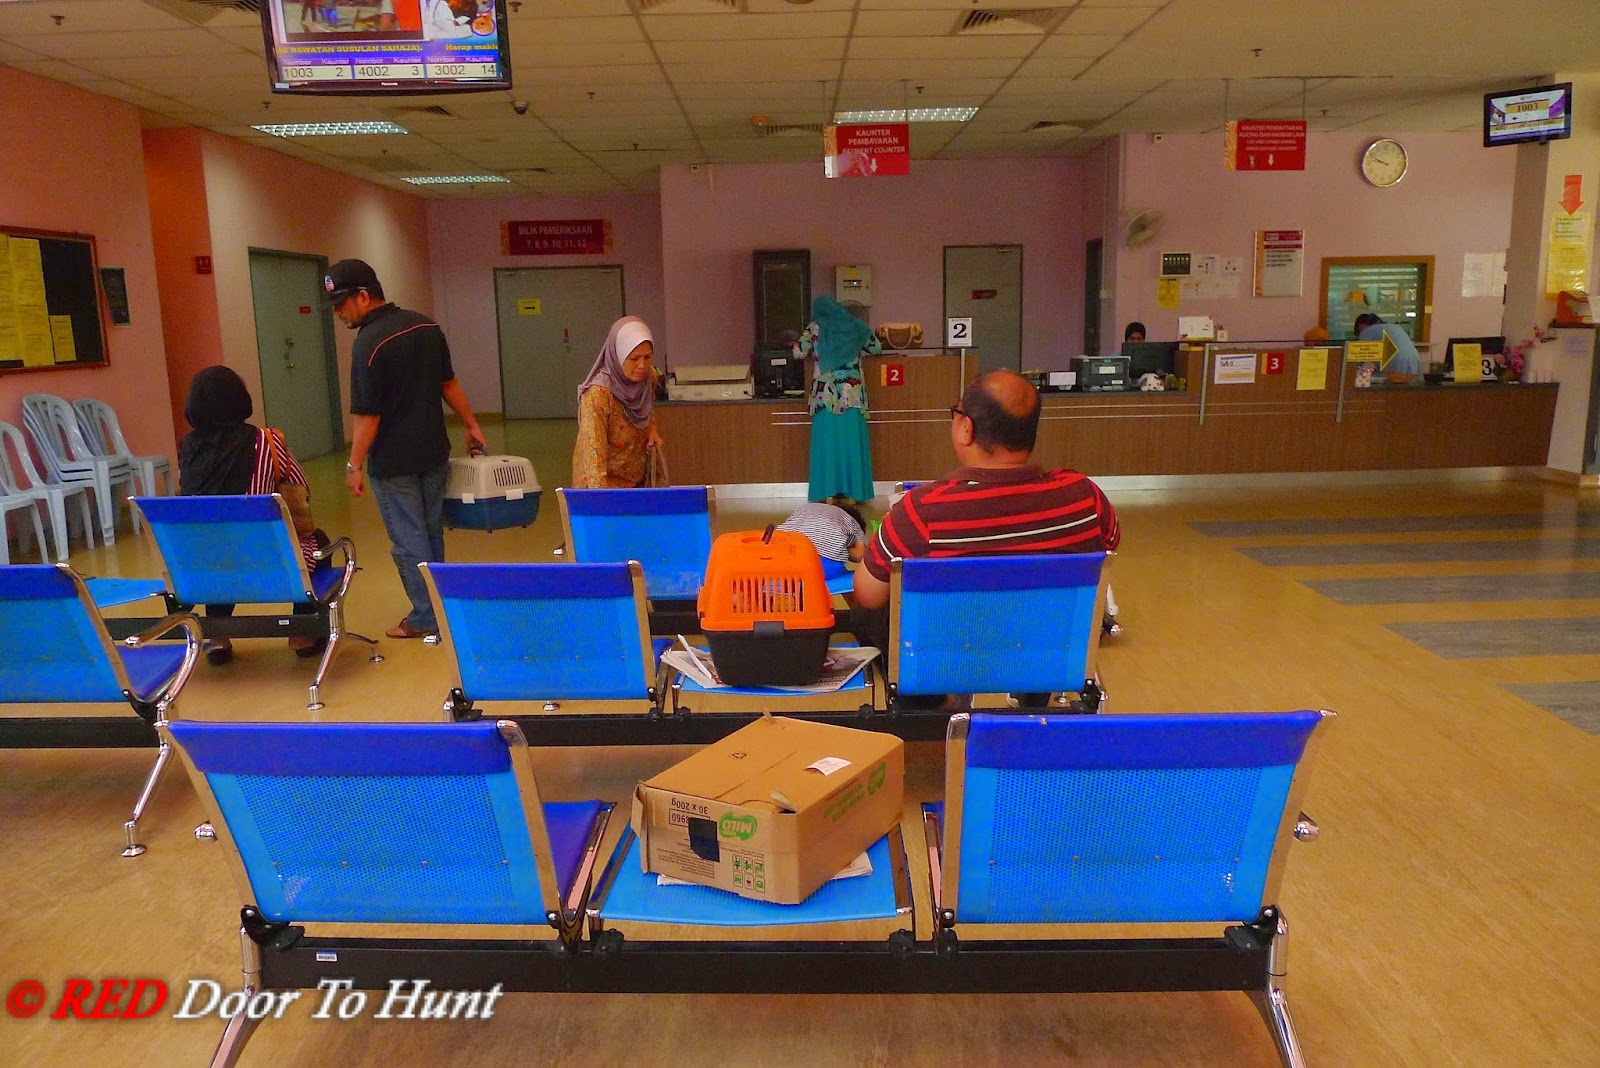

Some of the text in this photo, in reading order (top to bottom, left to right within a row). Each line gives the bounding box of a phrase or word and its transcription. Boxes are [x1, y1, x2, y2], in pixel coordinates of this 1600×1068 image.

[284, 65, 496, 78] 1003 2 4002 3 3002 14
[1517, 103, 1539, 112] 1003
[856, 129, 891, 137] KAUNTER
[848, 137, 898, 145] PEMBAYARAN
[873, 146, 905, 154] COUNTER
[540, 225, 593, 235] PEMERIKSAAN
[953, 323, 967, 339] 2
[1270, 358, 1279, 370] 3
[890, 369, 899, 381] 2
[671, 798, 690, 811] 200g
[698, 806, 708, 815] 30
[721, 819, 753, 834] MILO
